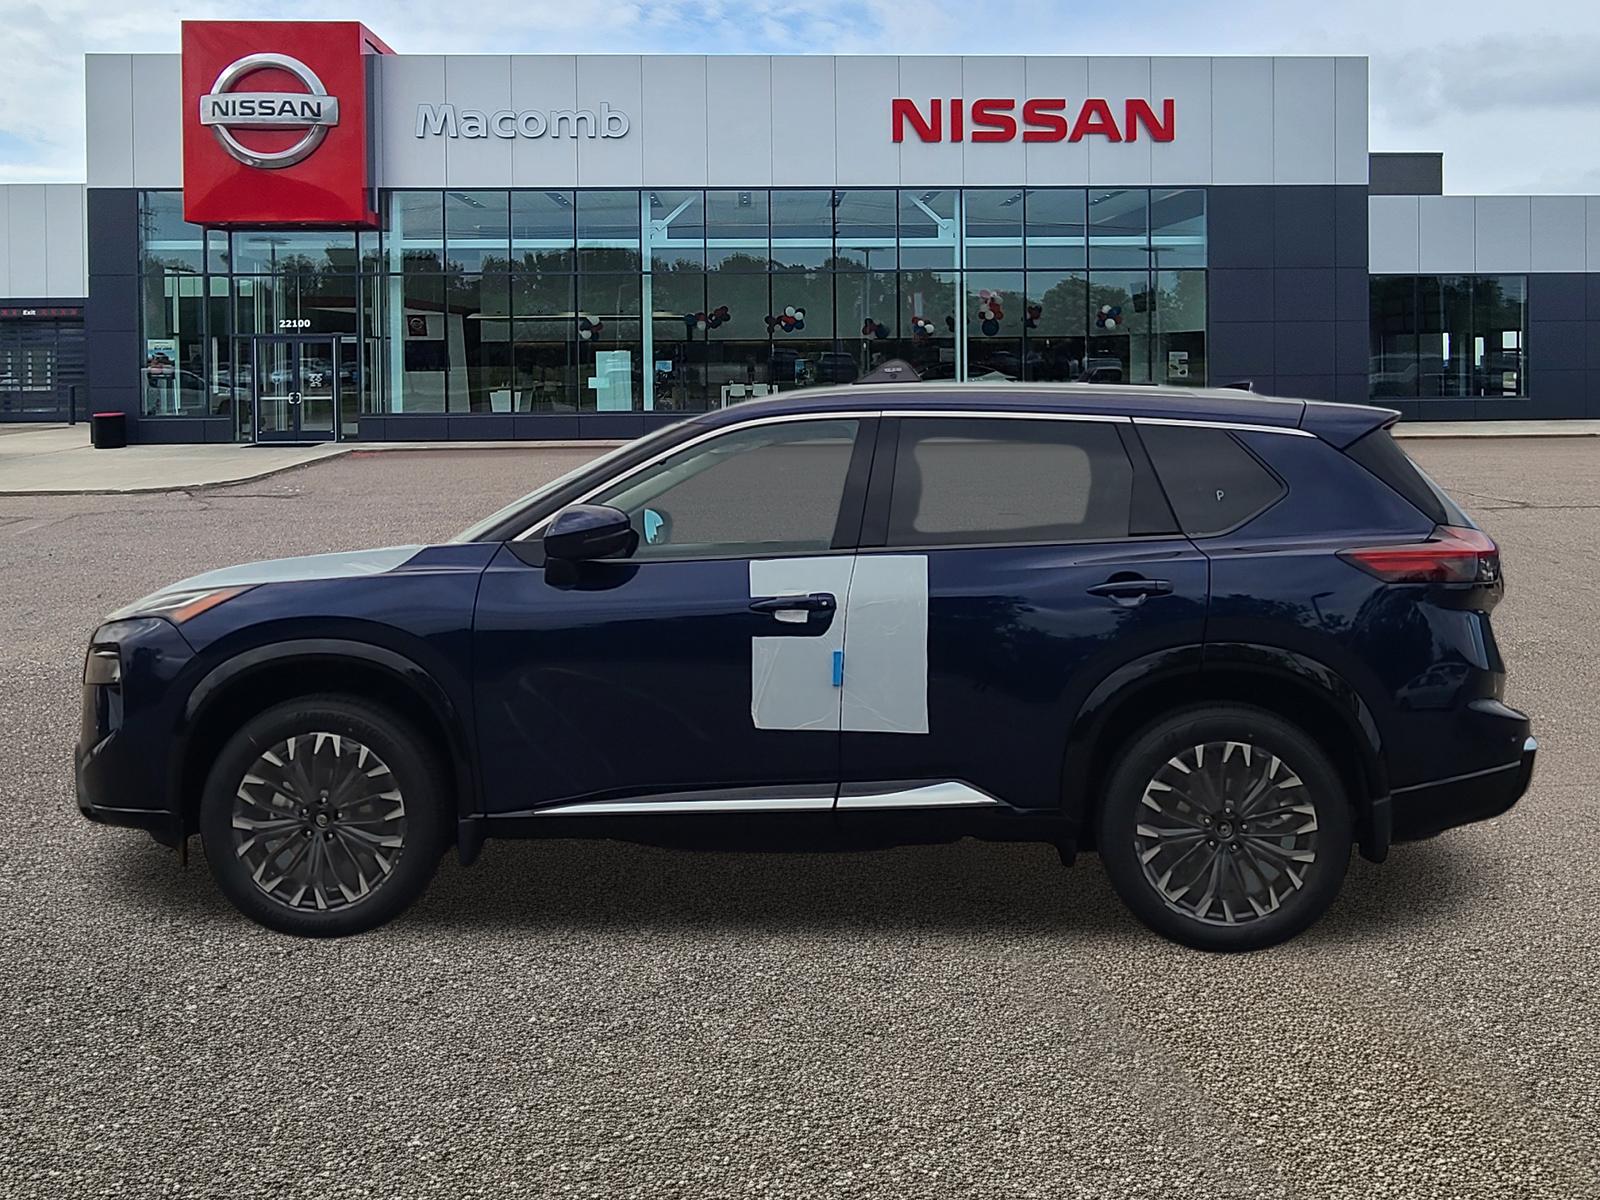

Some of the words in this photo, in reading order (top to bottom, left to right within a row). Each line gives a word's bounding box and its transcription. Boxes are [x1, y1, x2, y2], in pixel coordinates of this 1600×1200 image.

[212, 99, 322, 117] NISSAN
[415, 102, 630, 139] Macomb
[891, 98, 1175, 143] NISSAN
[279, 319, 311, 328] 22100
